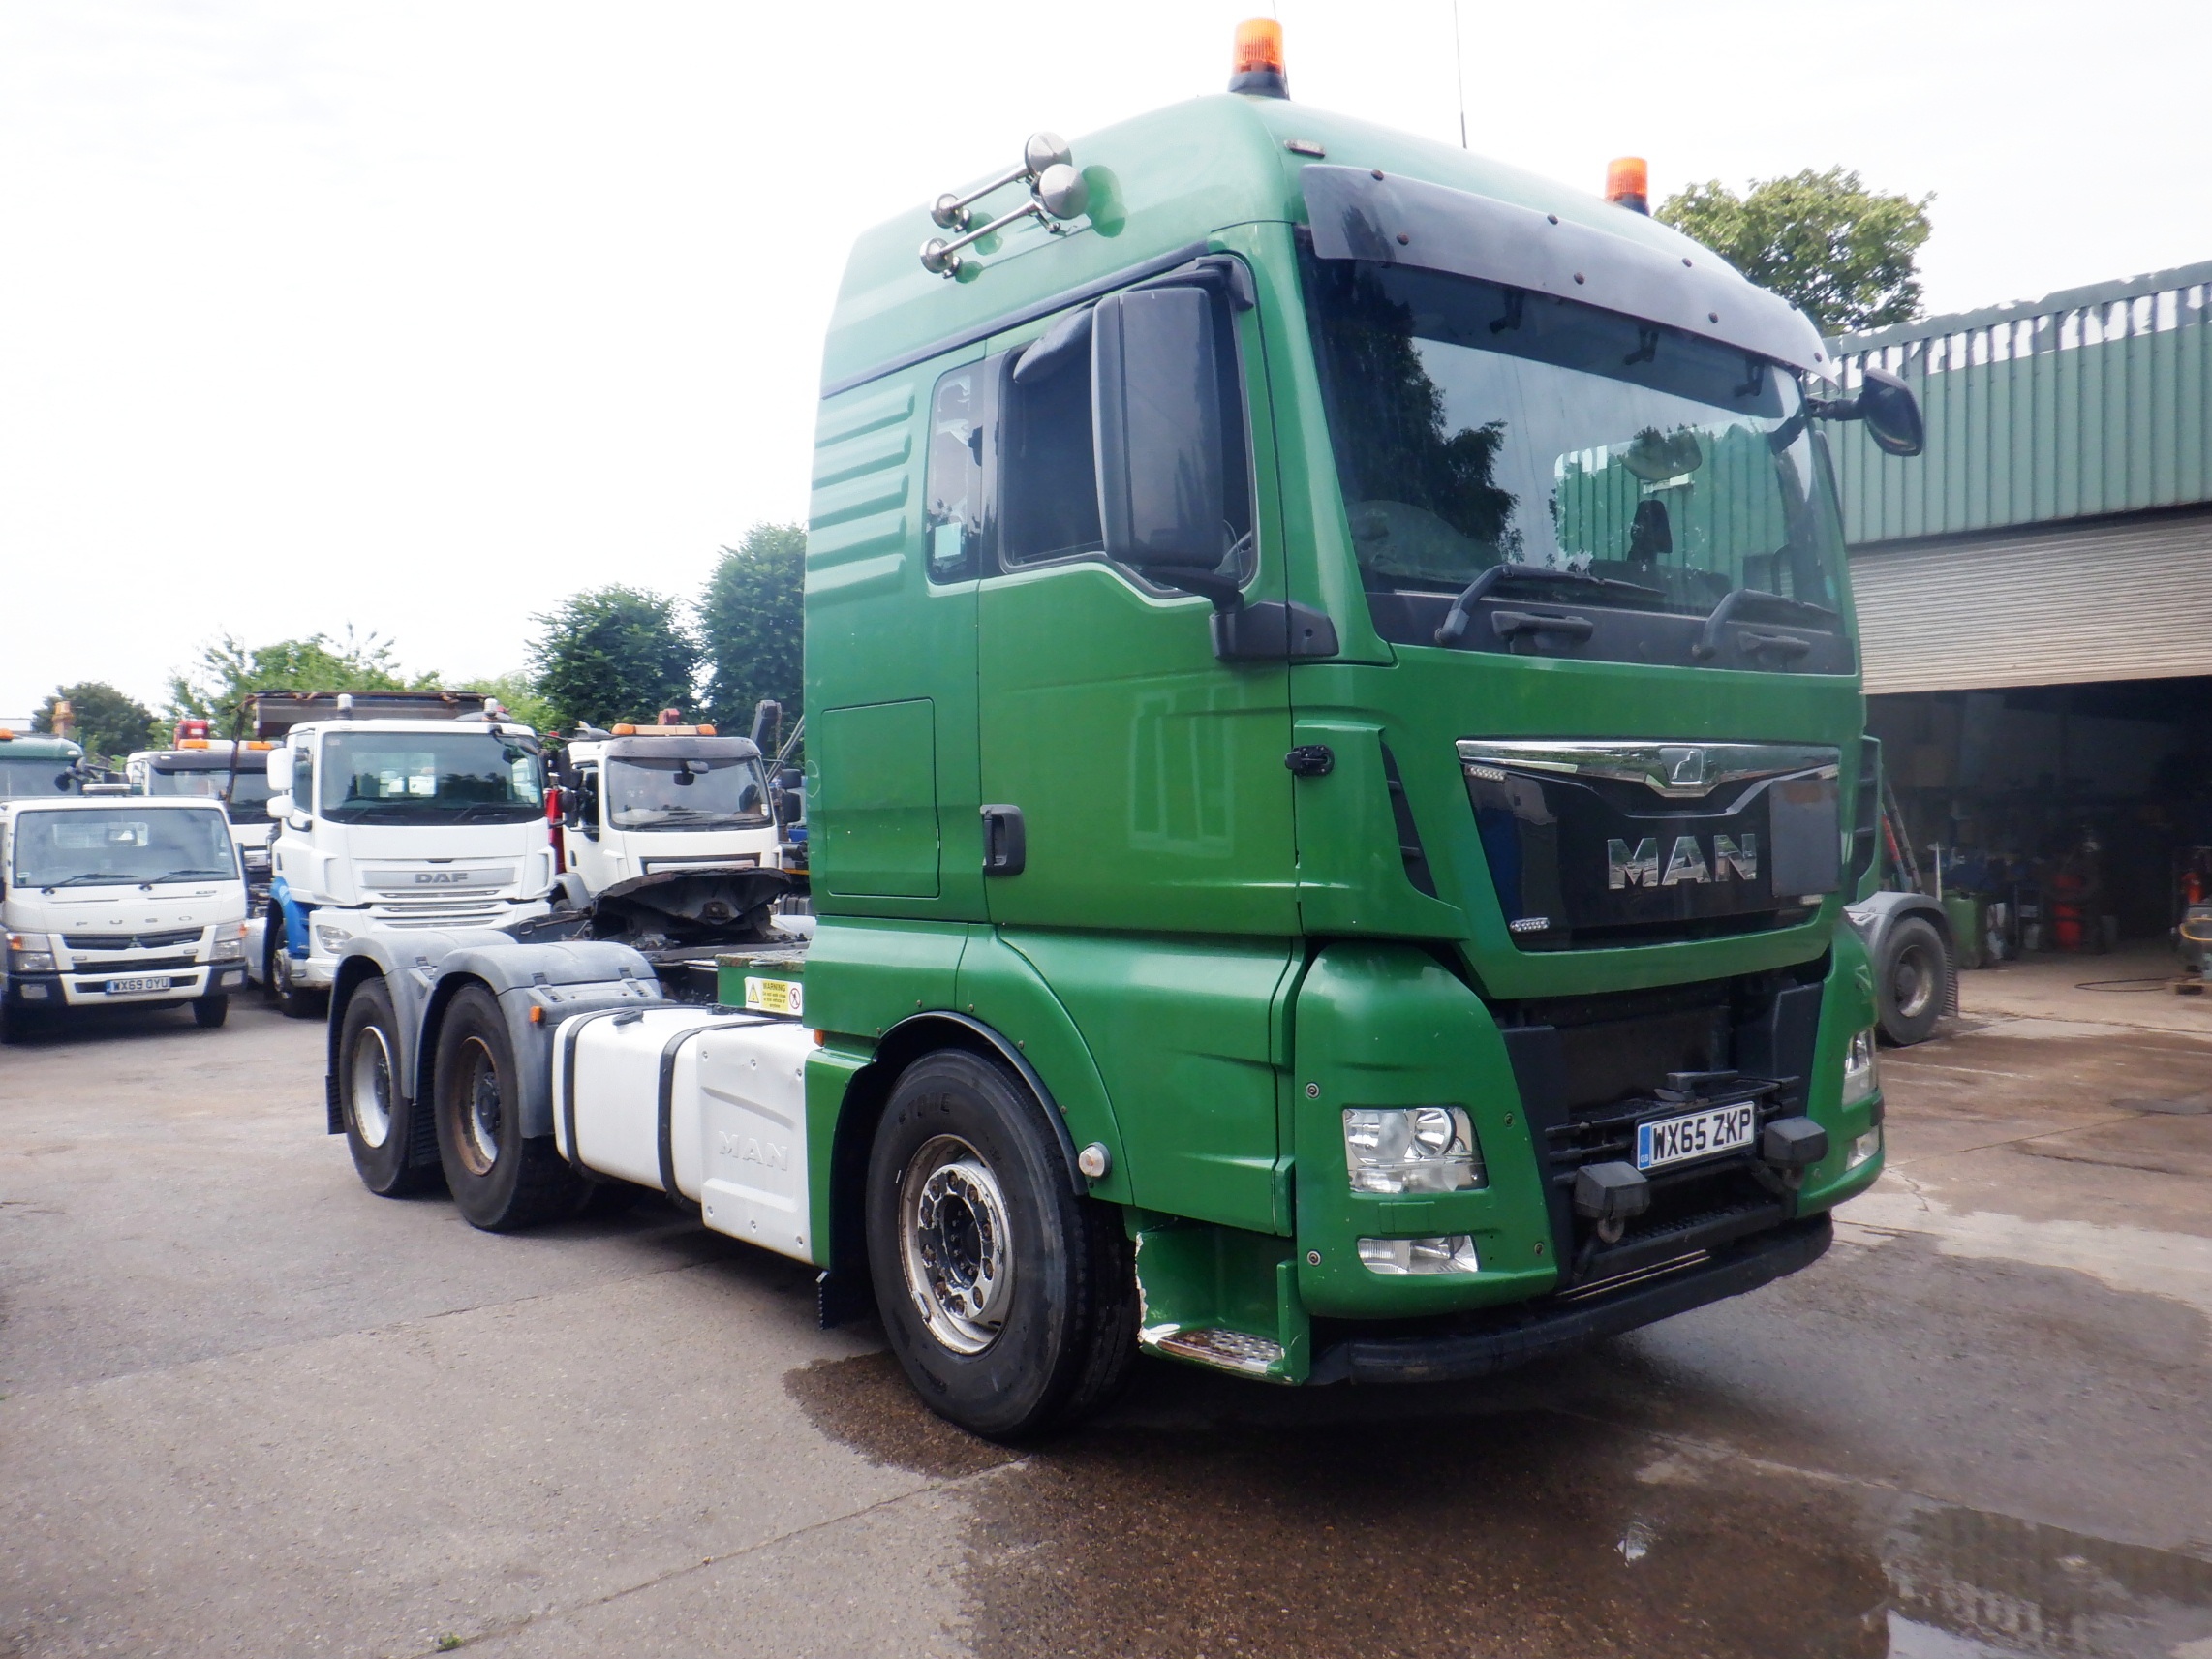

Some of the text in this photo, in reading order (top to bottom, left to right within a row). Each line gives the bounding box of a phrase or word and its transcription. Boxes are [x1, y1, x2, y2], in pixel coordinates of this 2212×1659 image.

[415, 873, 468, 883] DAF
[1607, 833, 1758, 890] MAN
[113, 979, 143, 992] WX69
[718, 1130, 788, 1171] MAN
[1653, 1108, 1751, 1160] WX65 ZKP
